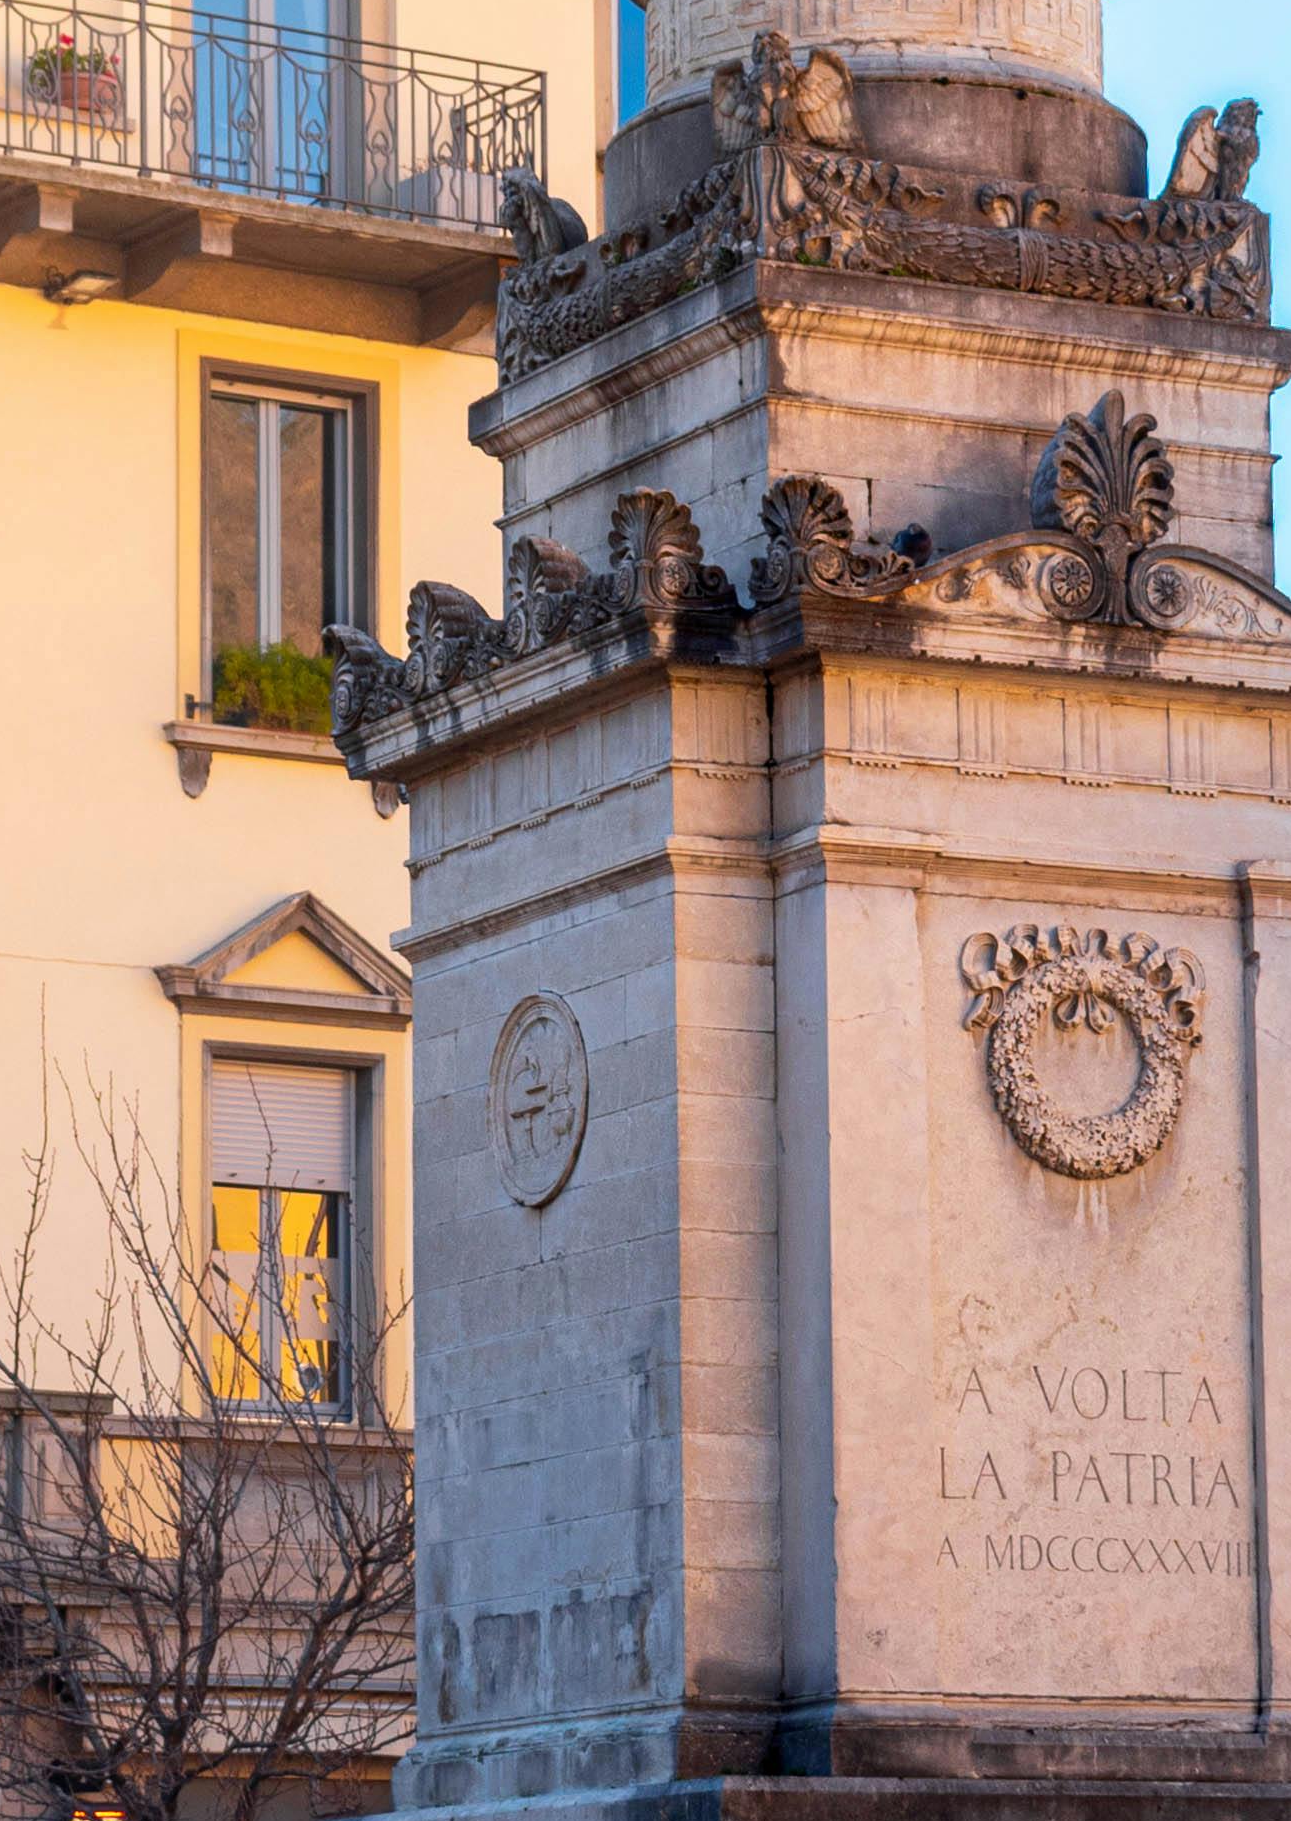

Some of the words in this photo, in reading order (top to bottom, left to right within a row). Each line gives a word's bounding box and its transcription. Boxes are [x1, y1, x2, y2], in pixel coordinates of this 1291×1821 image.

[956, 1366, 993, 1415] A
[1032, 1365, 1222, 1425] VOLTA
[939, 1446, 1008, 1500] LA
[1050, 1449, 1240, 1509] PATRIA
[985, 1533, 1252, 1578] MDCCCXXXVIII
